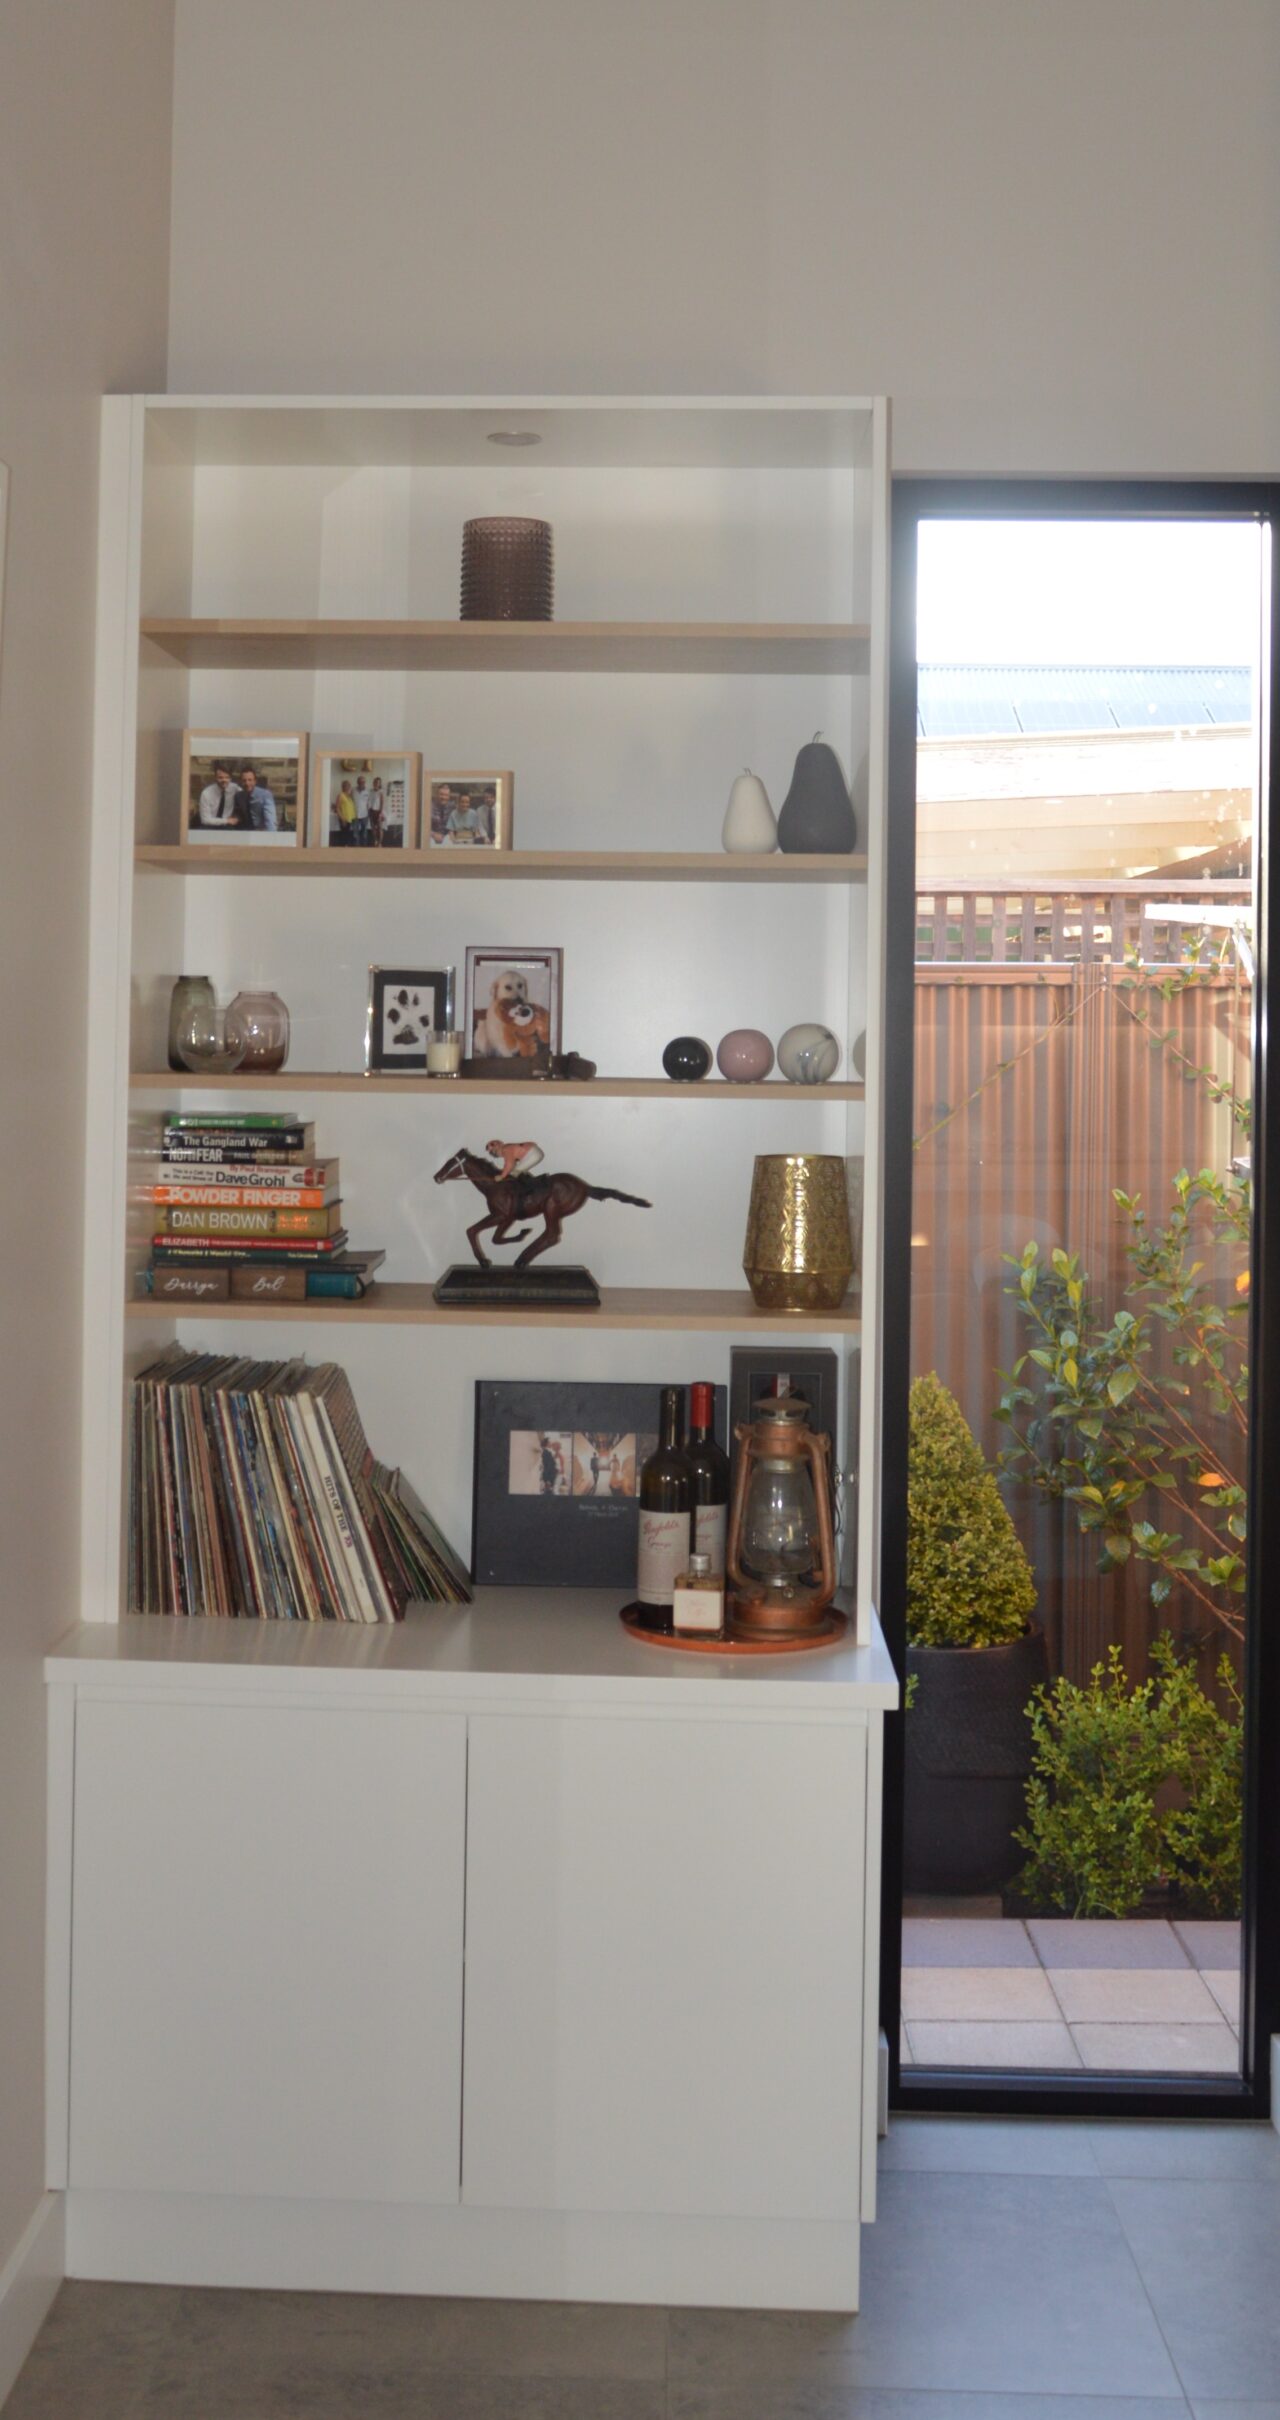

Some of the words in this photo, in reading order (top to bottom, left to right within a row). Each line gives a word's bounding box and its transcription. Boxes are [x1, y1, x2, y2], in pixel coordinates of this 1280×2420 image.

[184, 1136, 200, 1146] The
[202, 1136, 246, 1149] Gangland
[249, 1136, 268, 1147] War
[169, 1187, 239, 1204] POWDER
[243, 1190, 301, 1206] FINGER
[172, 1211, 204, 1228] DAN
[209, 1212, 268, 1230] BROWN
[162, 1237, 209, 1247] ELIZABETH
[324, 1475, 337, 1499] HITS
[331, 1499, 341, 1511] OF
[336, 1513, 348, 1532] THE
